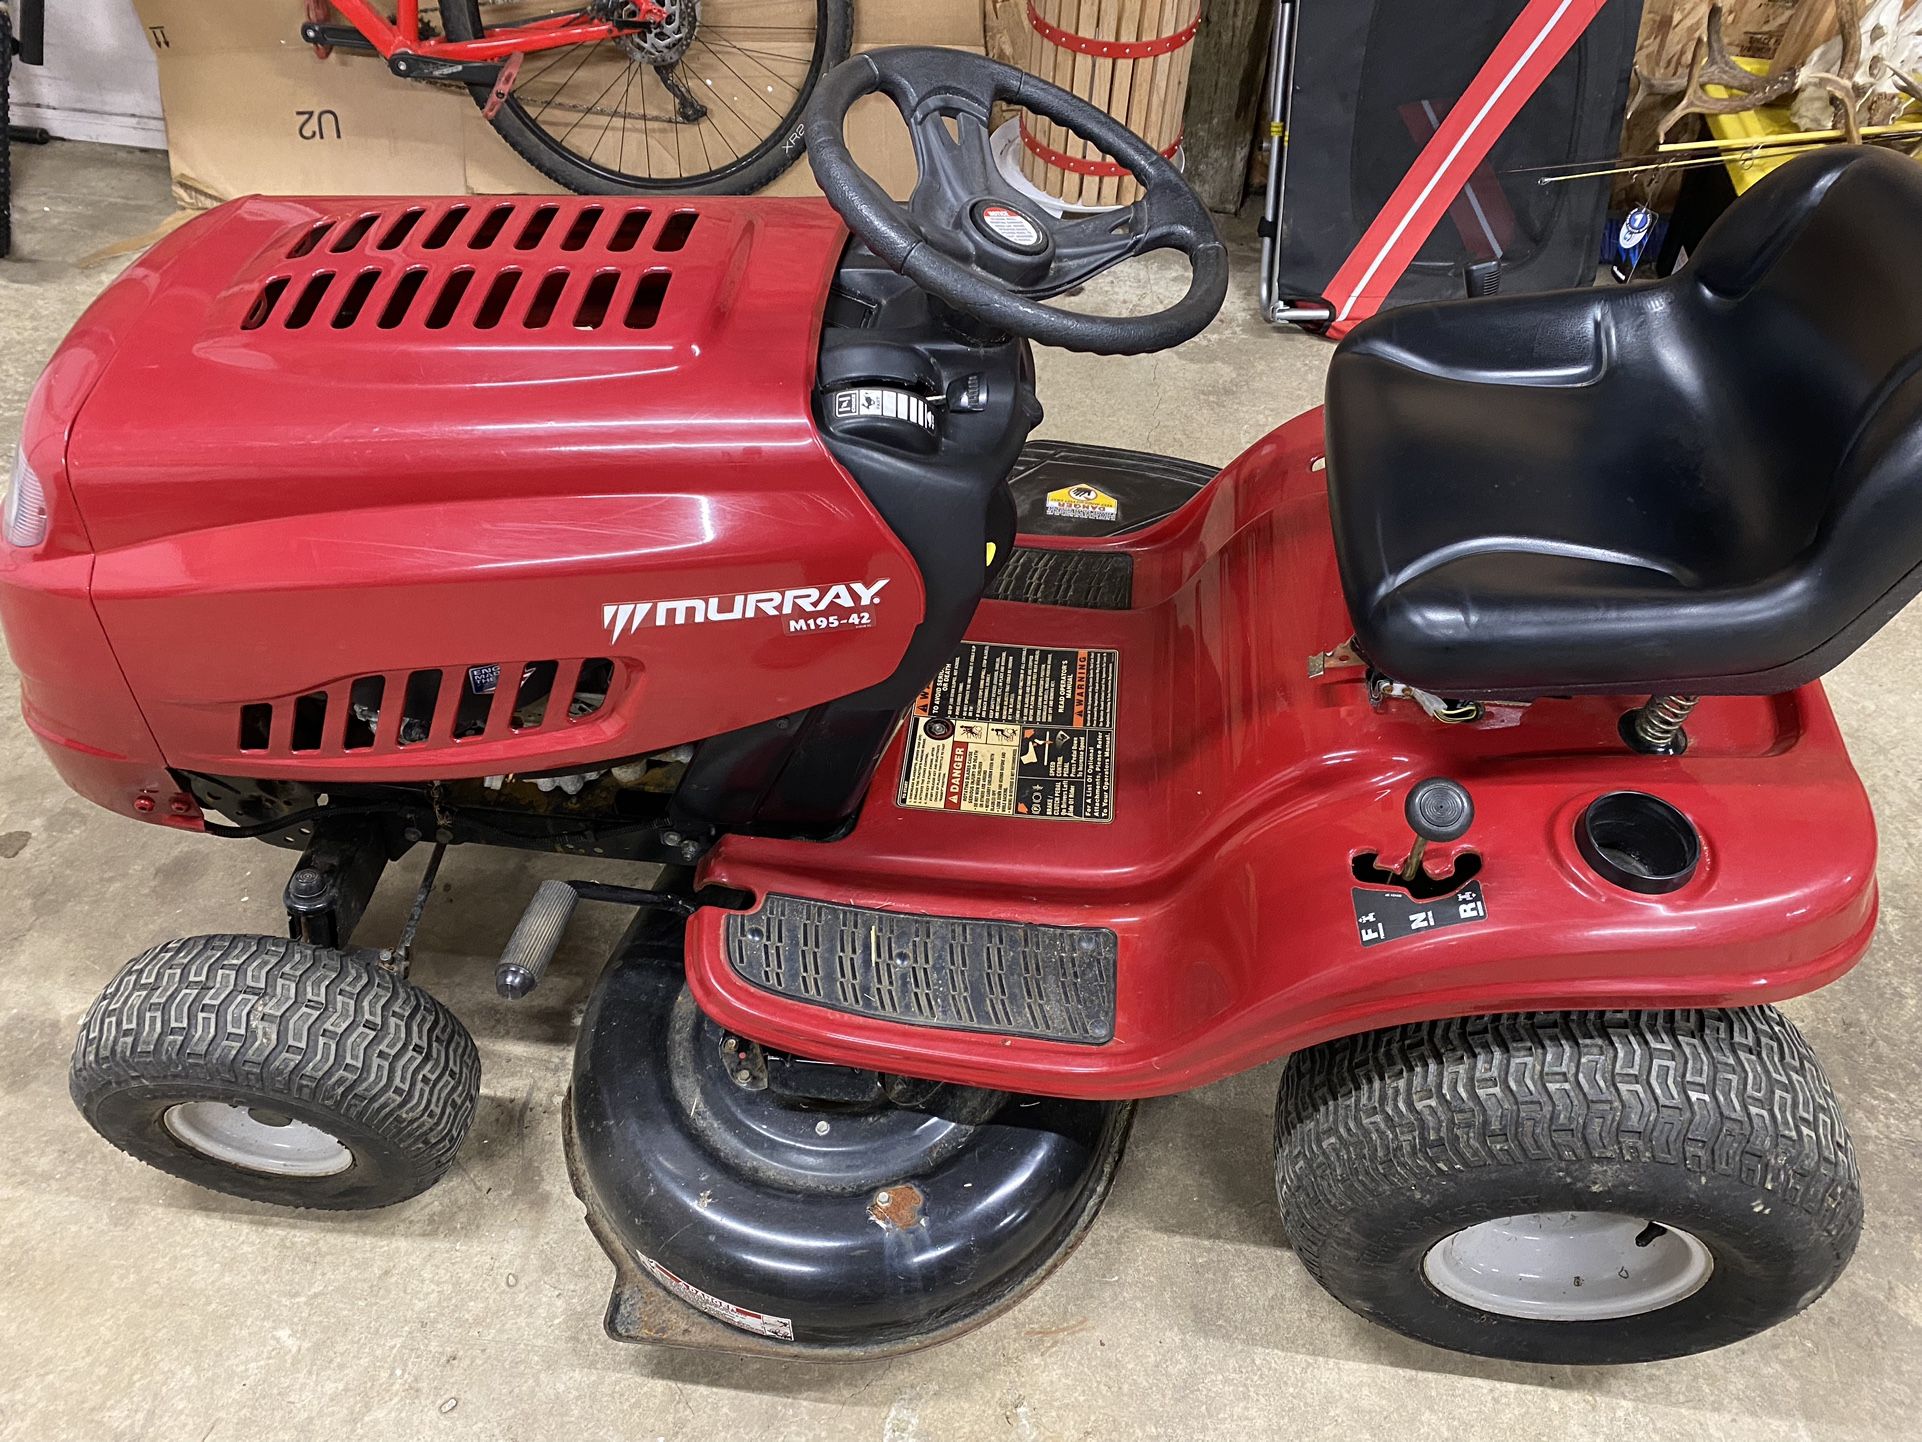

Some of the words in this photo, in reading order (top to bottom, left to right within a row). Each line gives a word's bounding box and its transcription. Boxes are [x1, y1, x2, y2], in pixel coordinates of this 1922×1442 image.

[296, 110, 341, 140] U2
[782, 124, 805, 153] XR2
[1633, 213, 1644, 228] 1
[655, 579, 890, 626] MURRAY
[789, 612, 871, 632] M195-42
[942, 682, 948, 691] OR
[1076, 656, 1085, 706] WARNING
[932, 705, 938, 713] TO
[950, 748, 964, 792] DANGER
[1102, 808, 1107, 816] To
[1459, 901, 1478, 918] R
[1409, 912, 1428, 929] N
[1361, 928, 1379, 941] F
